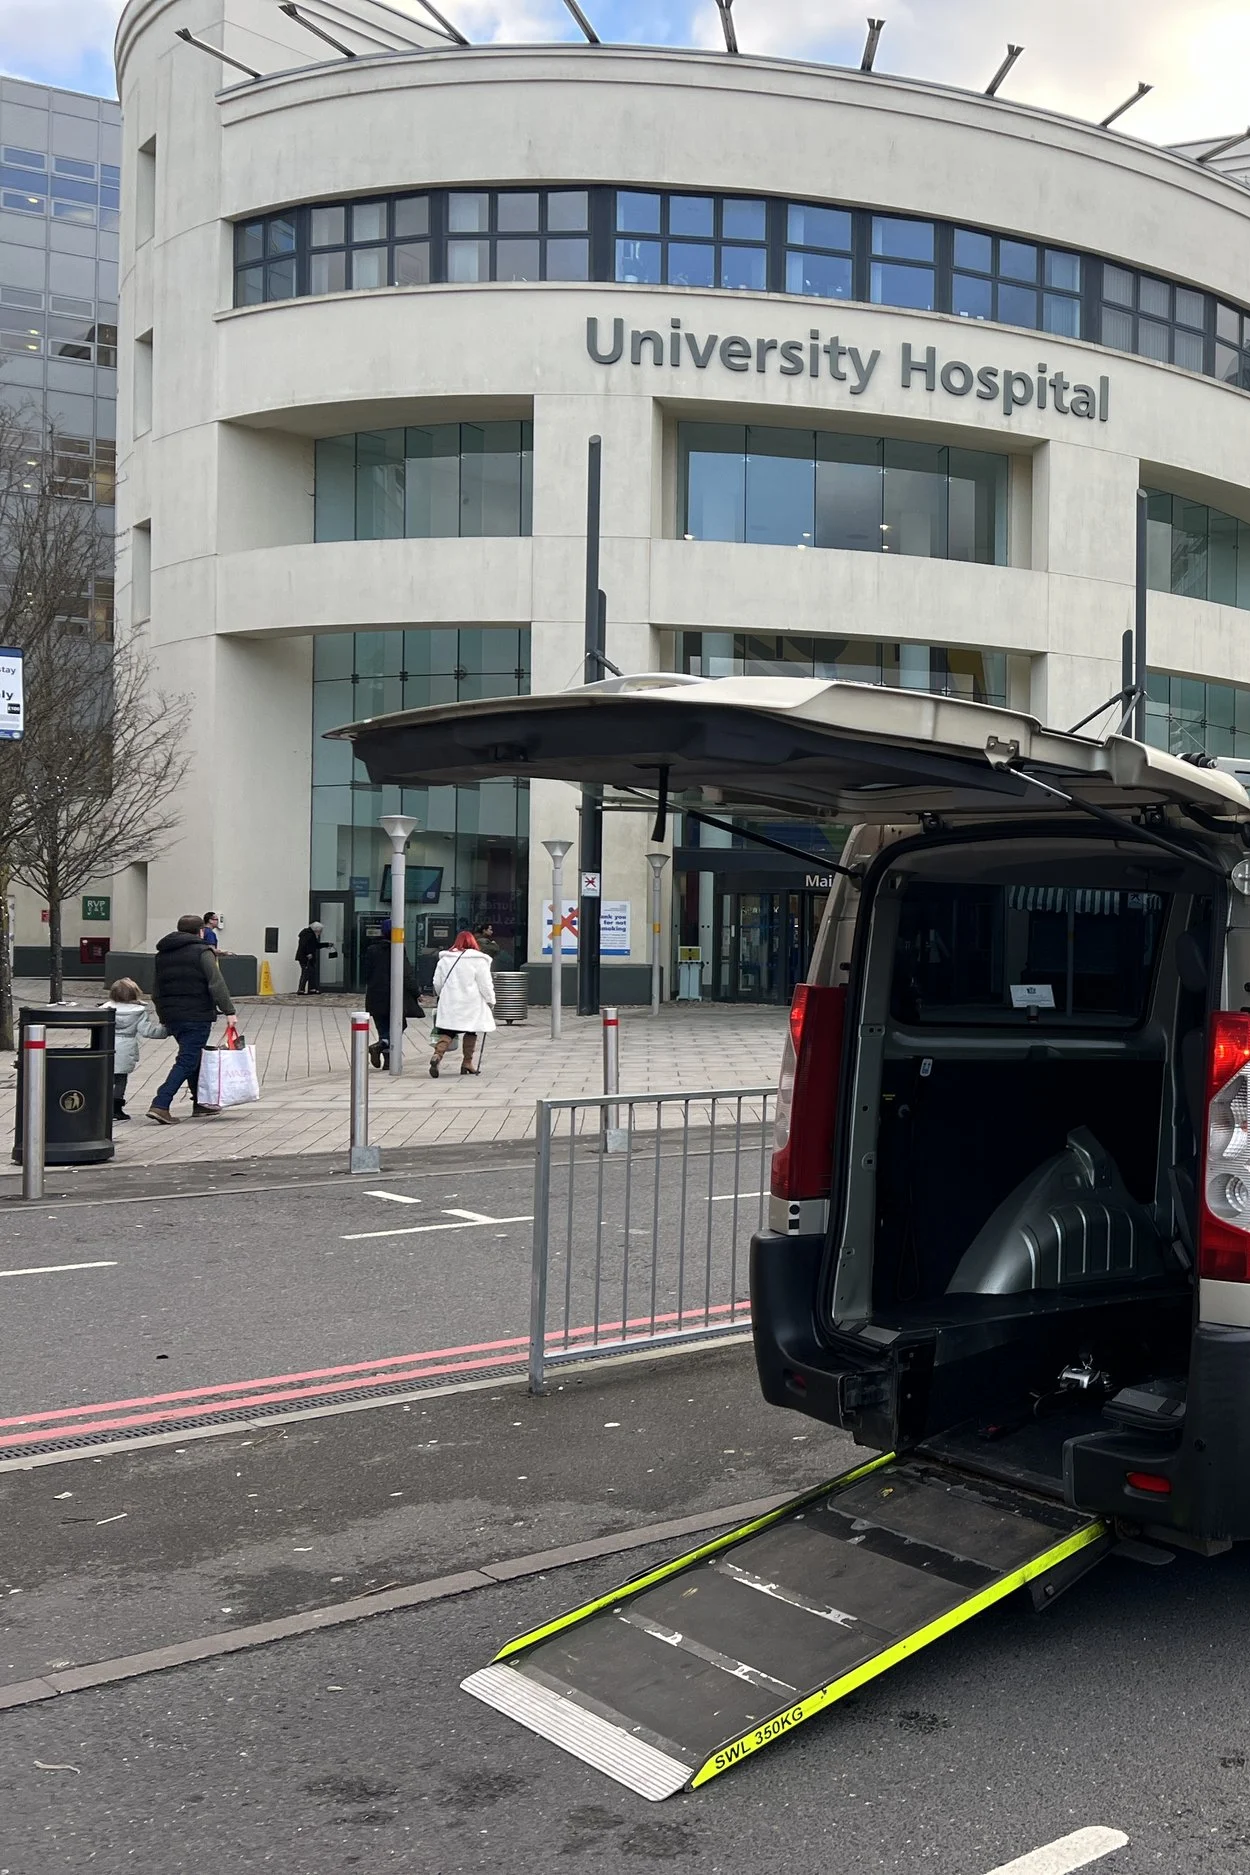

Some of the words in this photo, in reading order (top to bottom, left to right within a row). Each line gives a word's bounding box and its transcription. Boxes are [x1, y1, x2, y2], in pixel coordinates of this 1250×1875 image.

[586, 317, 881, 394] University
[900, 342, 1110, 421] Hospital
[805, 874, 833, 888] Mai
[714, 1741, 751, 1769] SWL
[754, 1706, 804, 1745] 350KG
